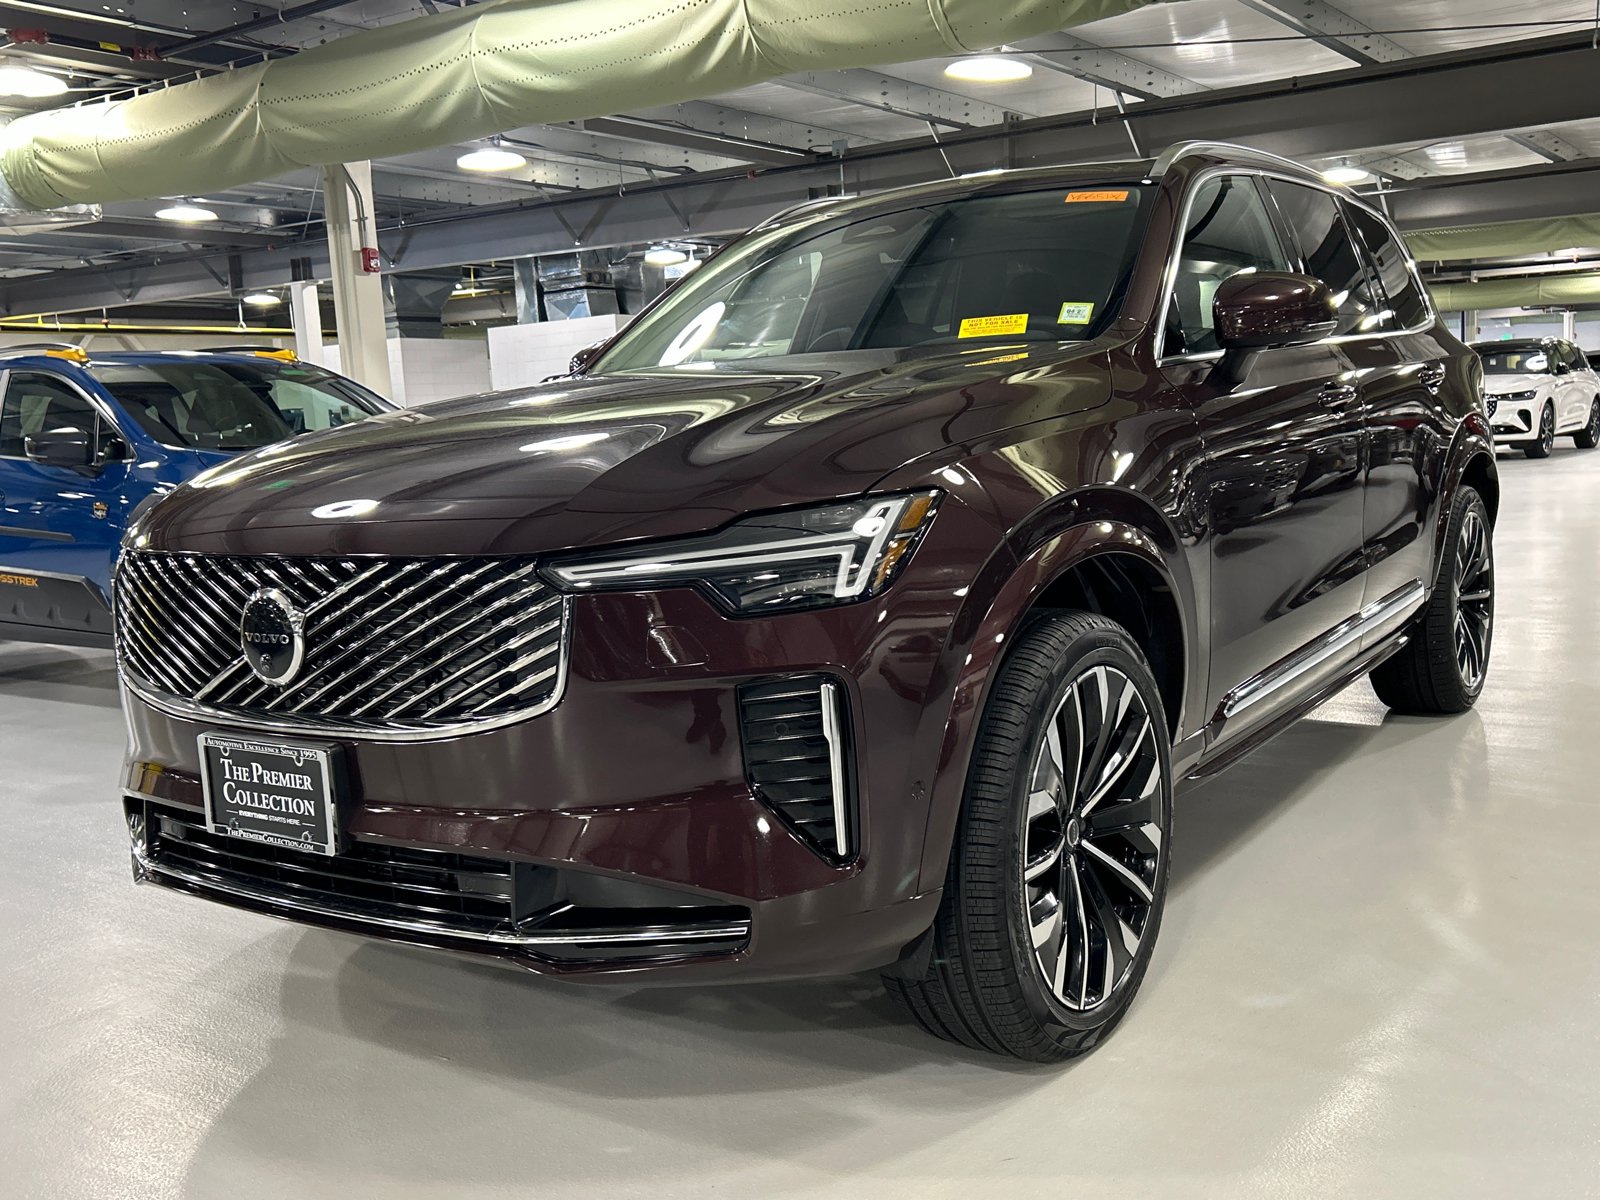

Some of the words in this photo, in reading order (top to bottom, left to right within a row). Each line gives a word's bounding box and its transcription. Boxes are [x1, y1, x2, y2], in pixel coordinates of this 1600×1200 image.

[244, 632, 290, 645] VOLVO
[207, 737, 243, 750] AUTOMOTIVE
[243, 742, 280, 754] EXCELLENCE
[280, 747, 299, 757] SINCE
[220, 757, 251, 783] THE
[250, 762, 314, 791] PREMIER
[223, 781, 316, 817] COLLECTION
[238, 810, 269, 821] EVERYTHING
[268, 815, 287, 824] STARTS
